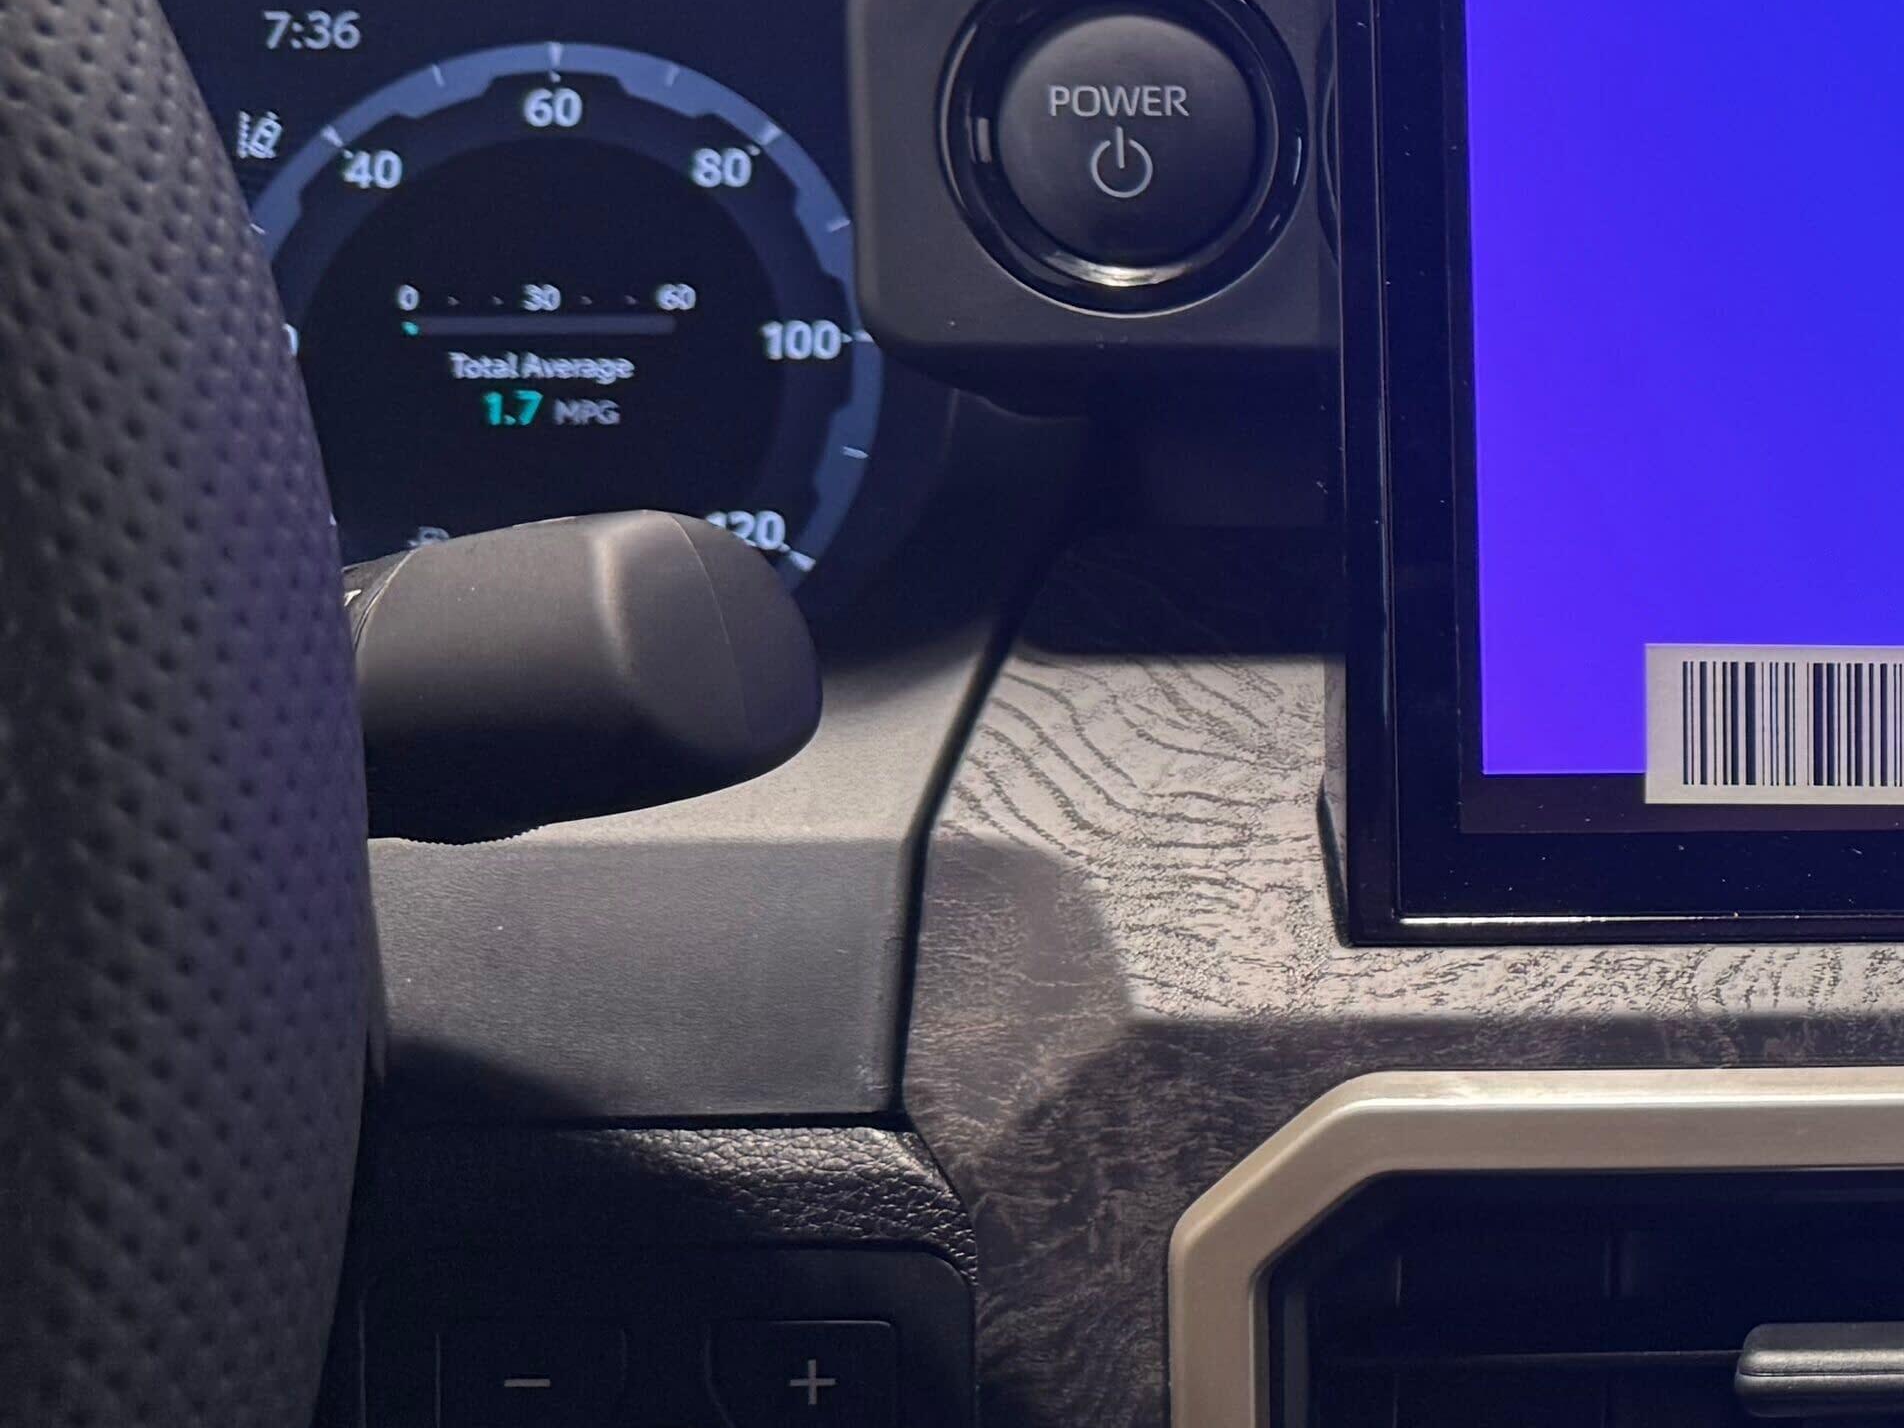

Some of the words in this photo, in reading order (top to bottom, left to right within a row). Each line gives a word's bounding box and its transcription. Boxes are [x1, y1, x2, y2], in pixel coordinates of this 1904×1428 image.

[260, 8, 363, 52] 7:36
[522, 87, 585, 129] 60
[1046, 83, 1192, 118] POWER
[343, 150, 403, 190] 40
[692, 147, 752, 189] 80
[399, 284, 419, 312] 0
[523, 283, 561, 312] 30
[655, 283, 697, 311] 60
[760, 319, 842, 361] 100
[448, 352, 520, 380] Total
[519, 352, 636, 386] Average
[482, 389, 544, 427] 1.7
[552, 398, 622, 427] MPG
